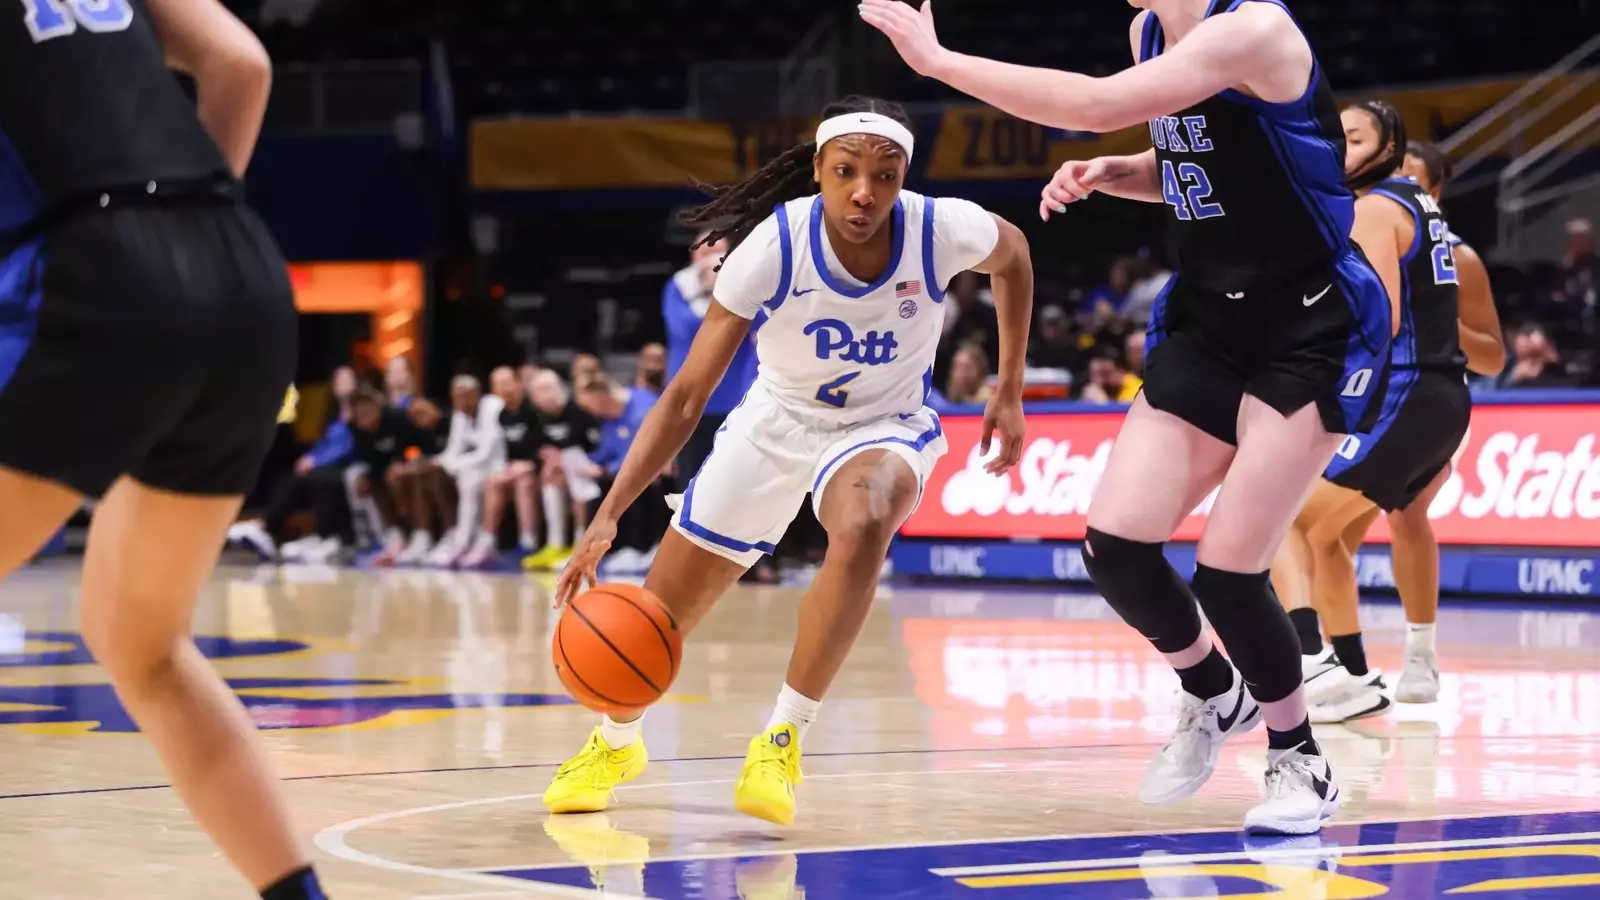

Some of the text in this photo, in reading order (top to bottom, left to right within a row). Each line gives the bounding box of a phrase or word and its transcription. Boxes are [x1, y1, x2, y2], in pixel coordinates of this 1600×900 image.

[1149, 115, 1214, 152] UKE
[1162, 160, 1225, 220] 42
[803, 318, 898, 366] Pitt
[1003, 437, 1115, 516] Stat
[1518, 558, 1594, 594] UPMC
